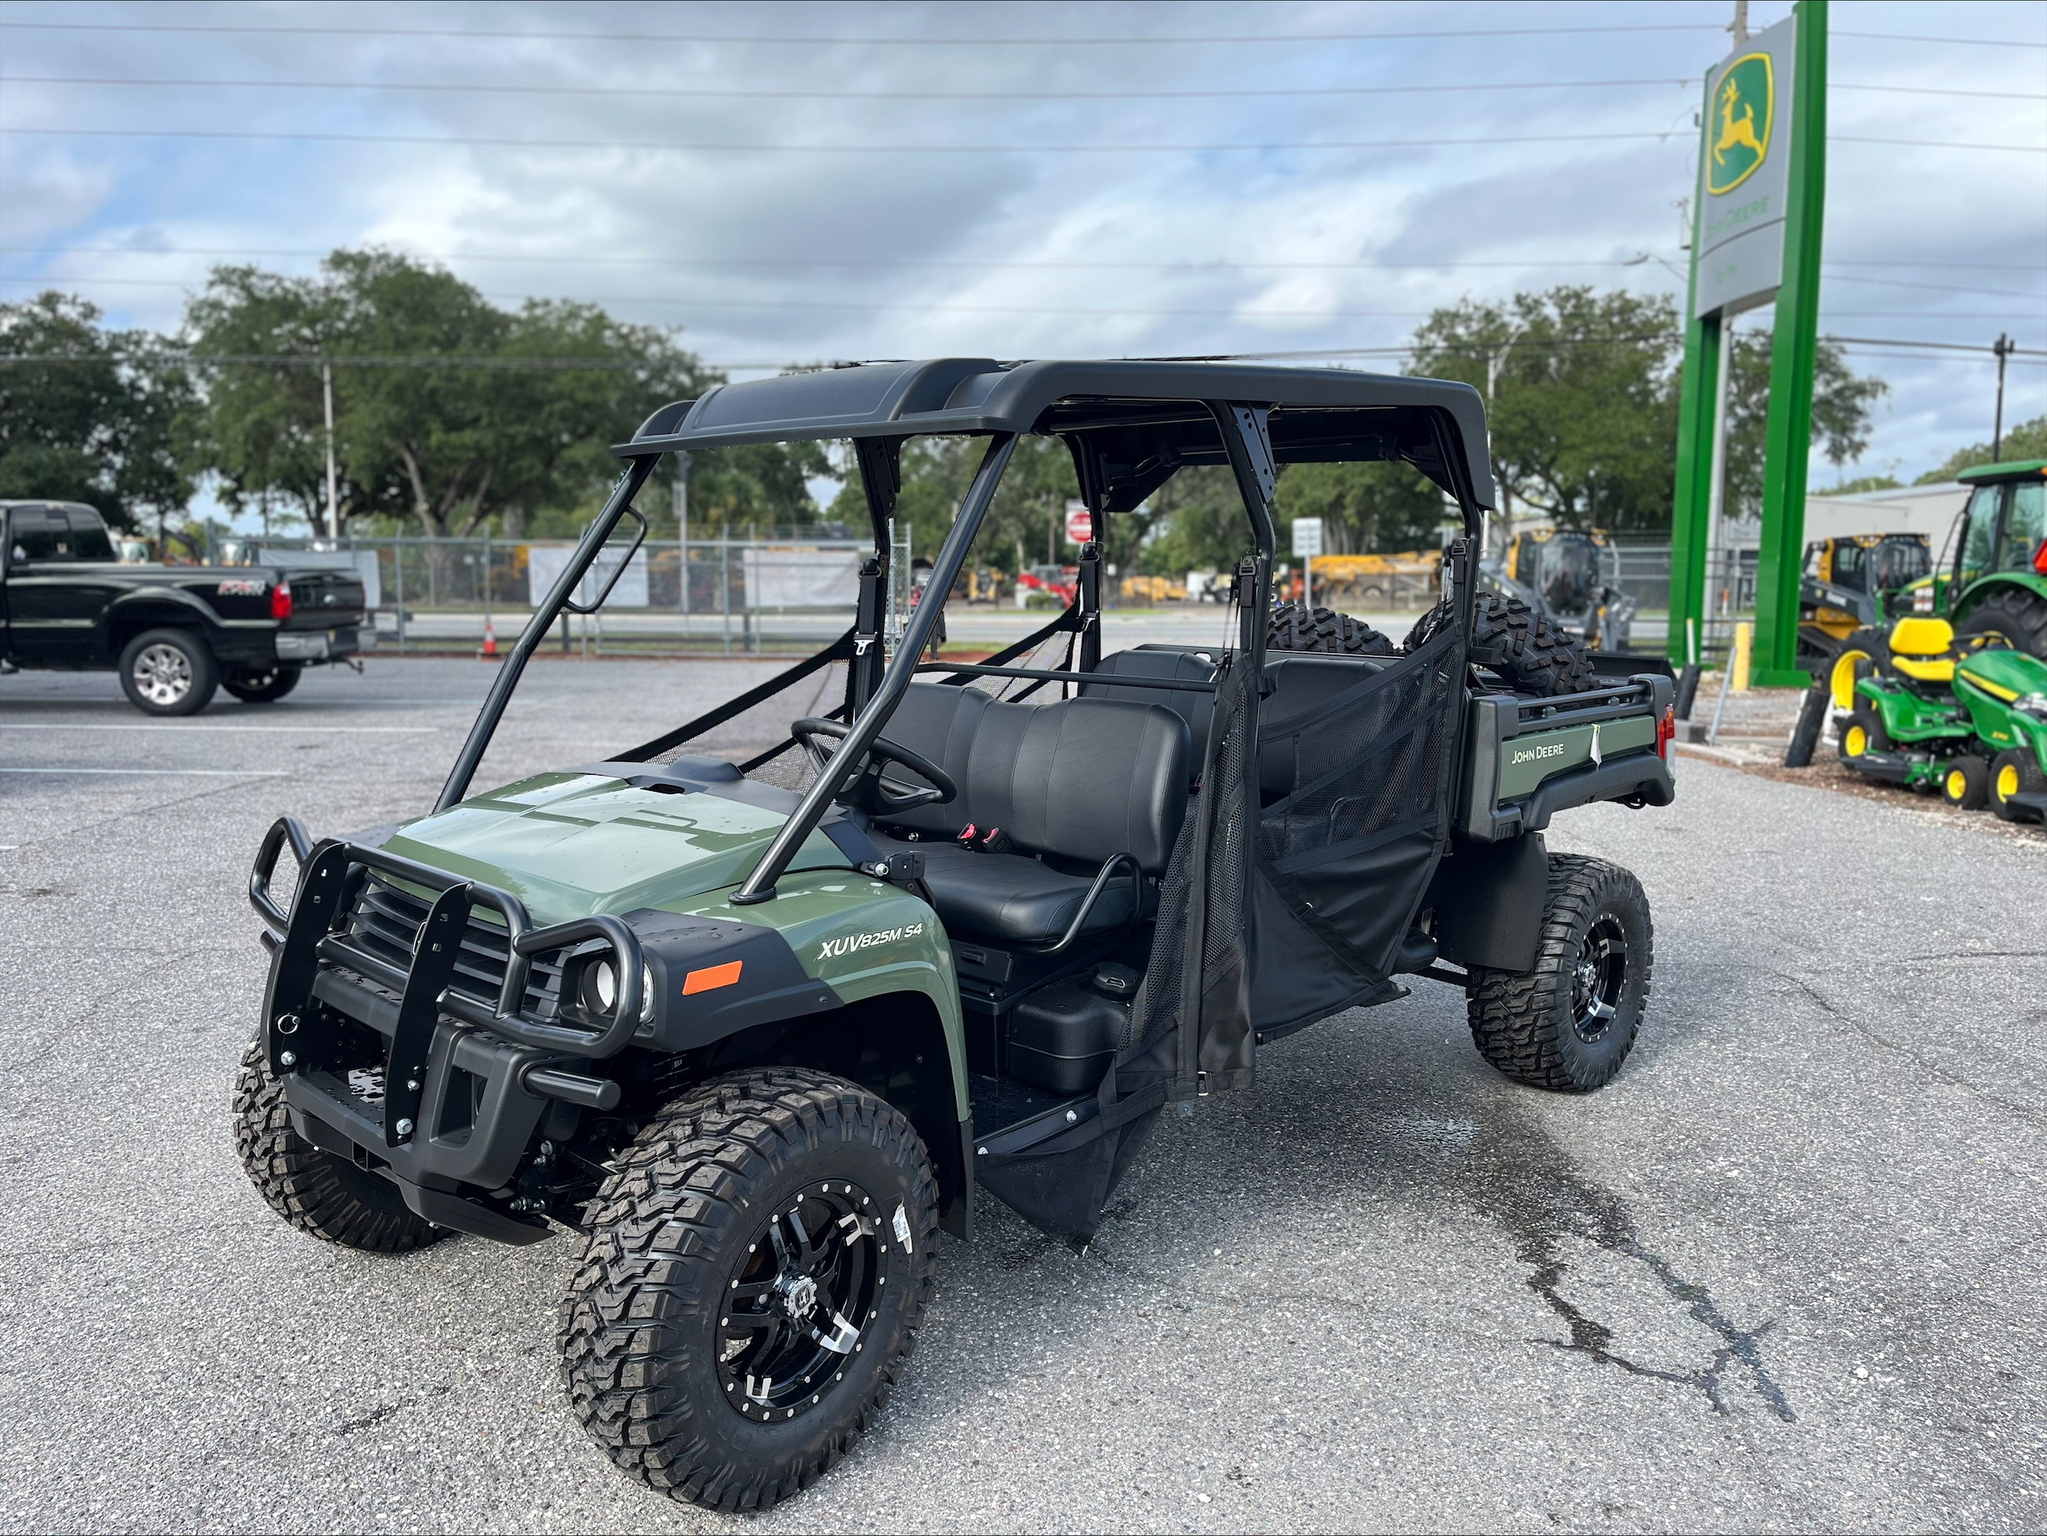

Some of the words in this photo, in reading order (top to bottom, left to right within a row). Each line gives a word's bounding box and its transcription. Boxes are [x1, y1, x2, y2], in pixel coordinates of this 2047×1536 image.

[1511, 748, 1535, 765] JOHN
[1536, 743, 1564, 760] DEERE
[815, 927, 902, 961] XUV825M
[903, 922, 923, 938] S4
